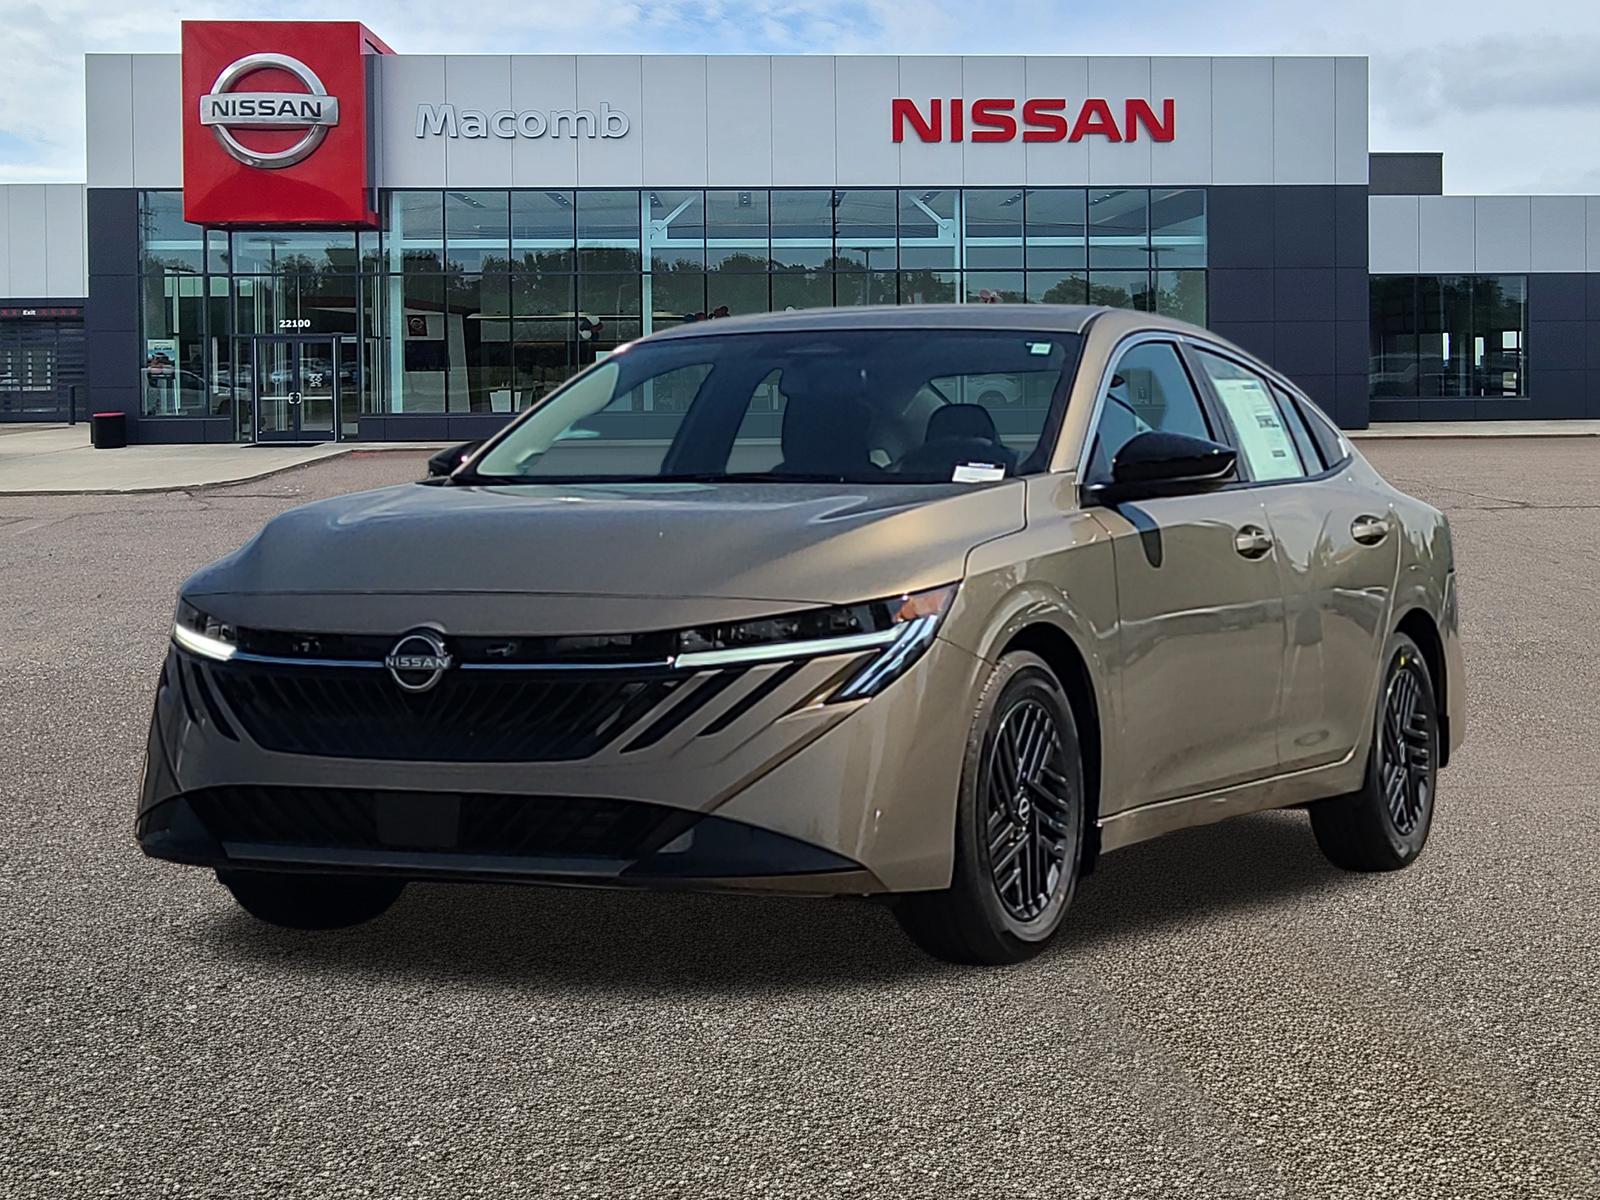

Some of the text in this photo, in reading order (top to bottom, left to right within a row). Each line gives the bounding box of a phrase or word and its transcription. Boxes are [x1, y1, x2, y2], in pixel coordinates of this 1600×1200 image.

[211, 100, 322, 117] NISSAN
[415, 102, 630, 139] Macomb
[892, 98, 1175, 143] NISSAN
[279, 319, 311, 328] 22100
[385, 656, 449, 668] NISSAN
